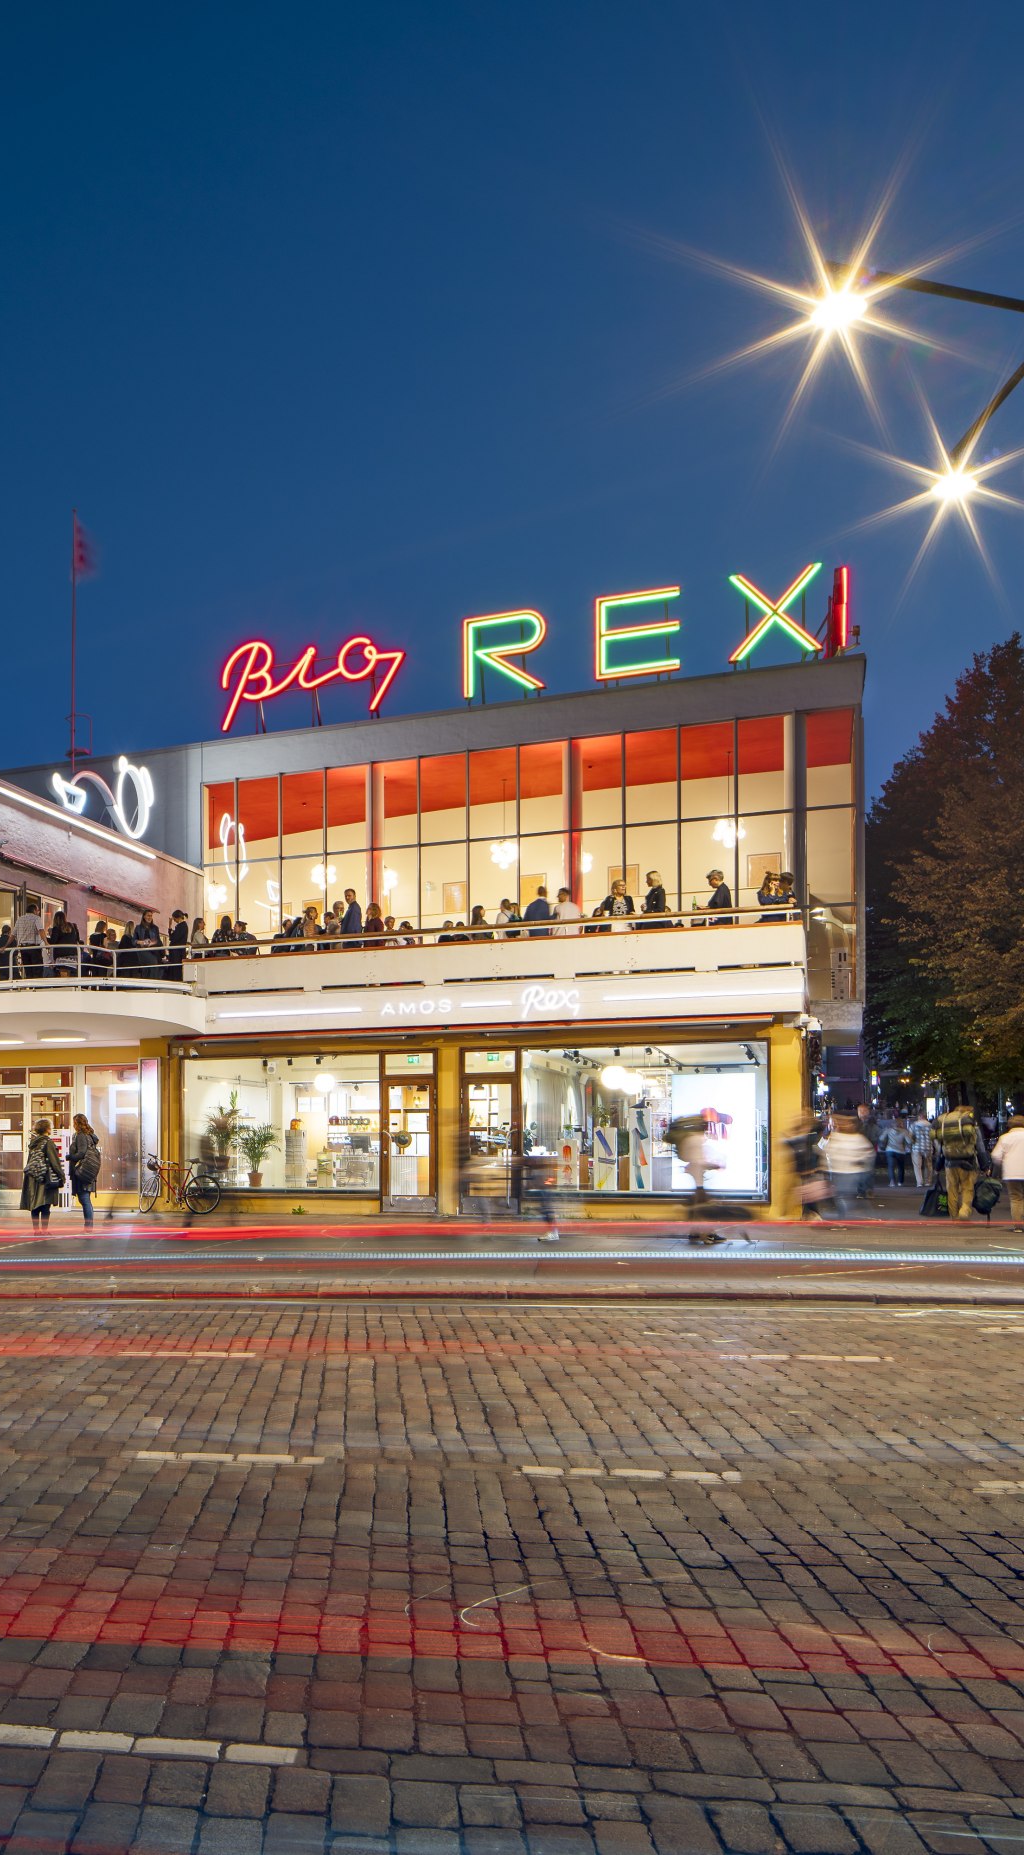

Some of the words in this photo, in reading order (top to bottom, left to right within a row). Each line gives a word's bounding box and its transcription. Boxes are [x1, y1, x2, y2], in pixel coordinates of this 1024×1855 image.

[222, 636, 407, 732] Bio
[462, 562, 823, 700] REX
[380, 998, 452, 1016] AMOS
[520, 985, 580, 1018] Rex
